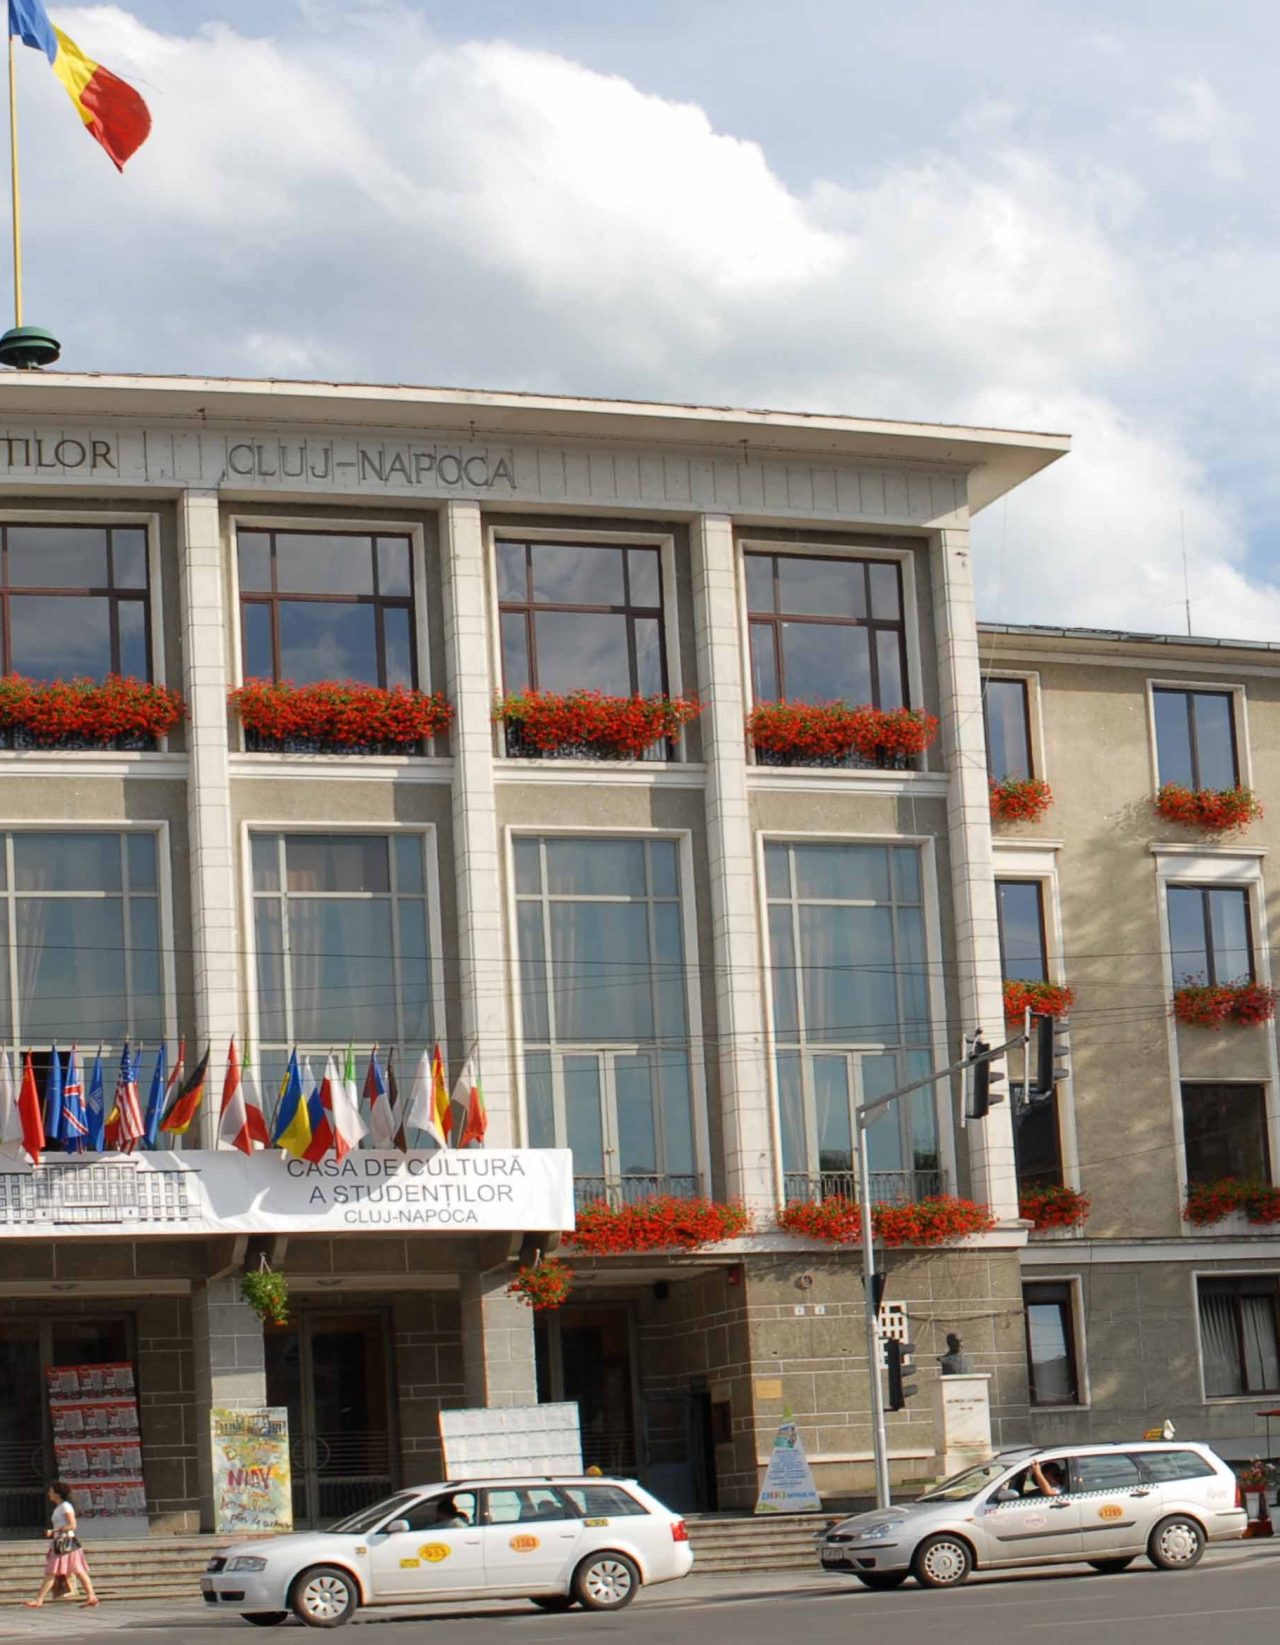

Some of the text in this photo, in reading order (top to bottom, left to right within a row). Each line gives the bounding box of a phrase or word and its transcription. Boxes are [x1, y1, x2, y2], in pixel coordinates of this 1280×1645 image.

[286, 1155, 525, 1177] CASA DE CULTURĂ
[309, 1186, 327, 1204] A
[344, 1209, 478, 1224] CLUJ-NAPOCA
